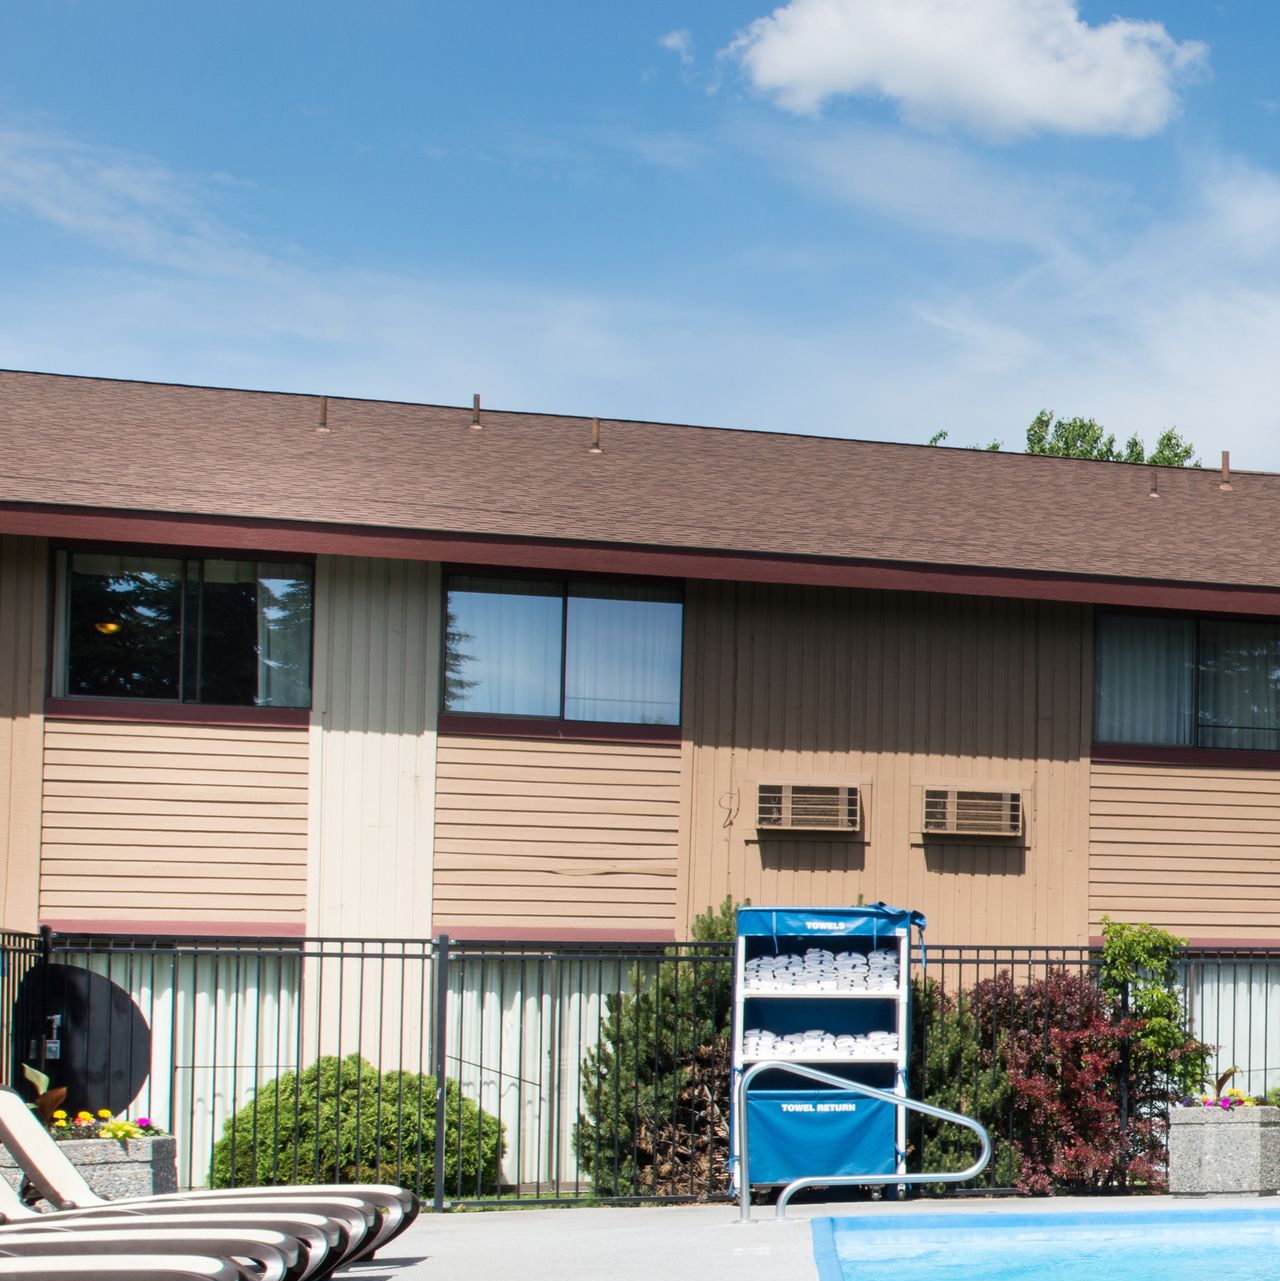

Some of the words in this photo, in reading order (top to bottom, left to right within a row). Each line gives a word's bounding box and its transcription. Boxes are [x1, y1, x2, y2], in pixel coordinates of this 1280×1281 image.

[805, 921, 846, 930] TOWELS
[781, 1103, 816, 1112] TOWEL
[816, 1103, 856, 1112] RETURN
